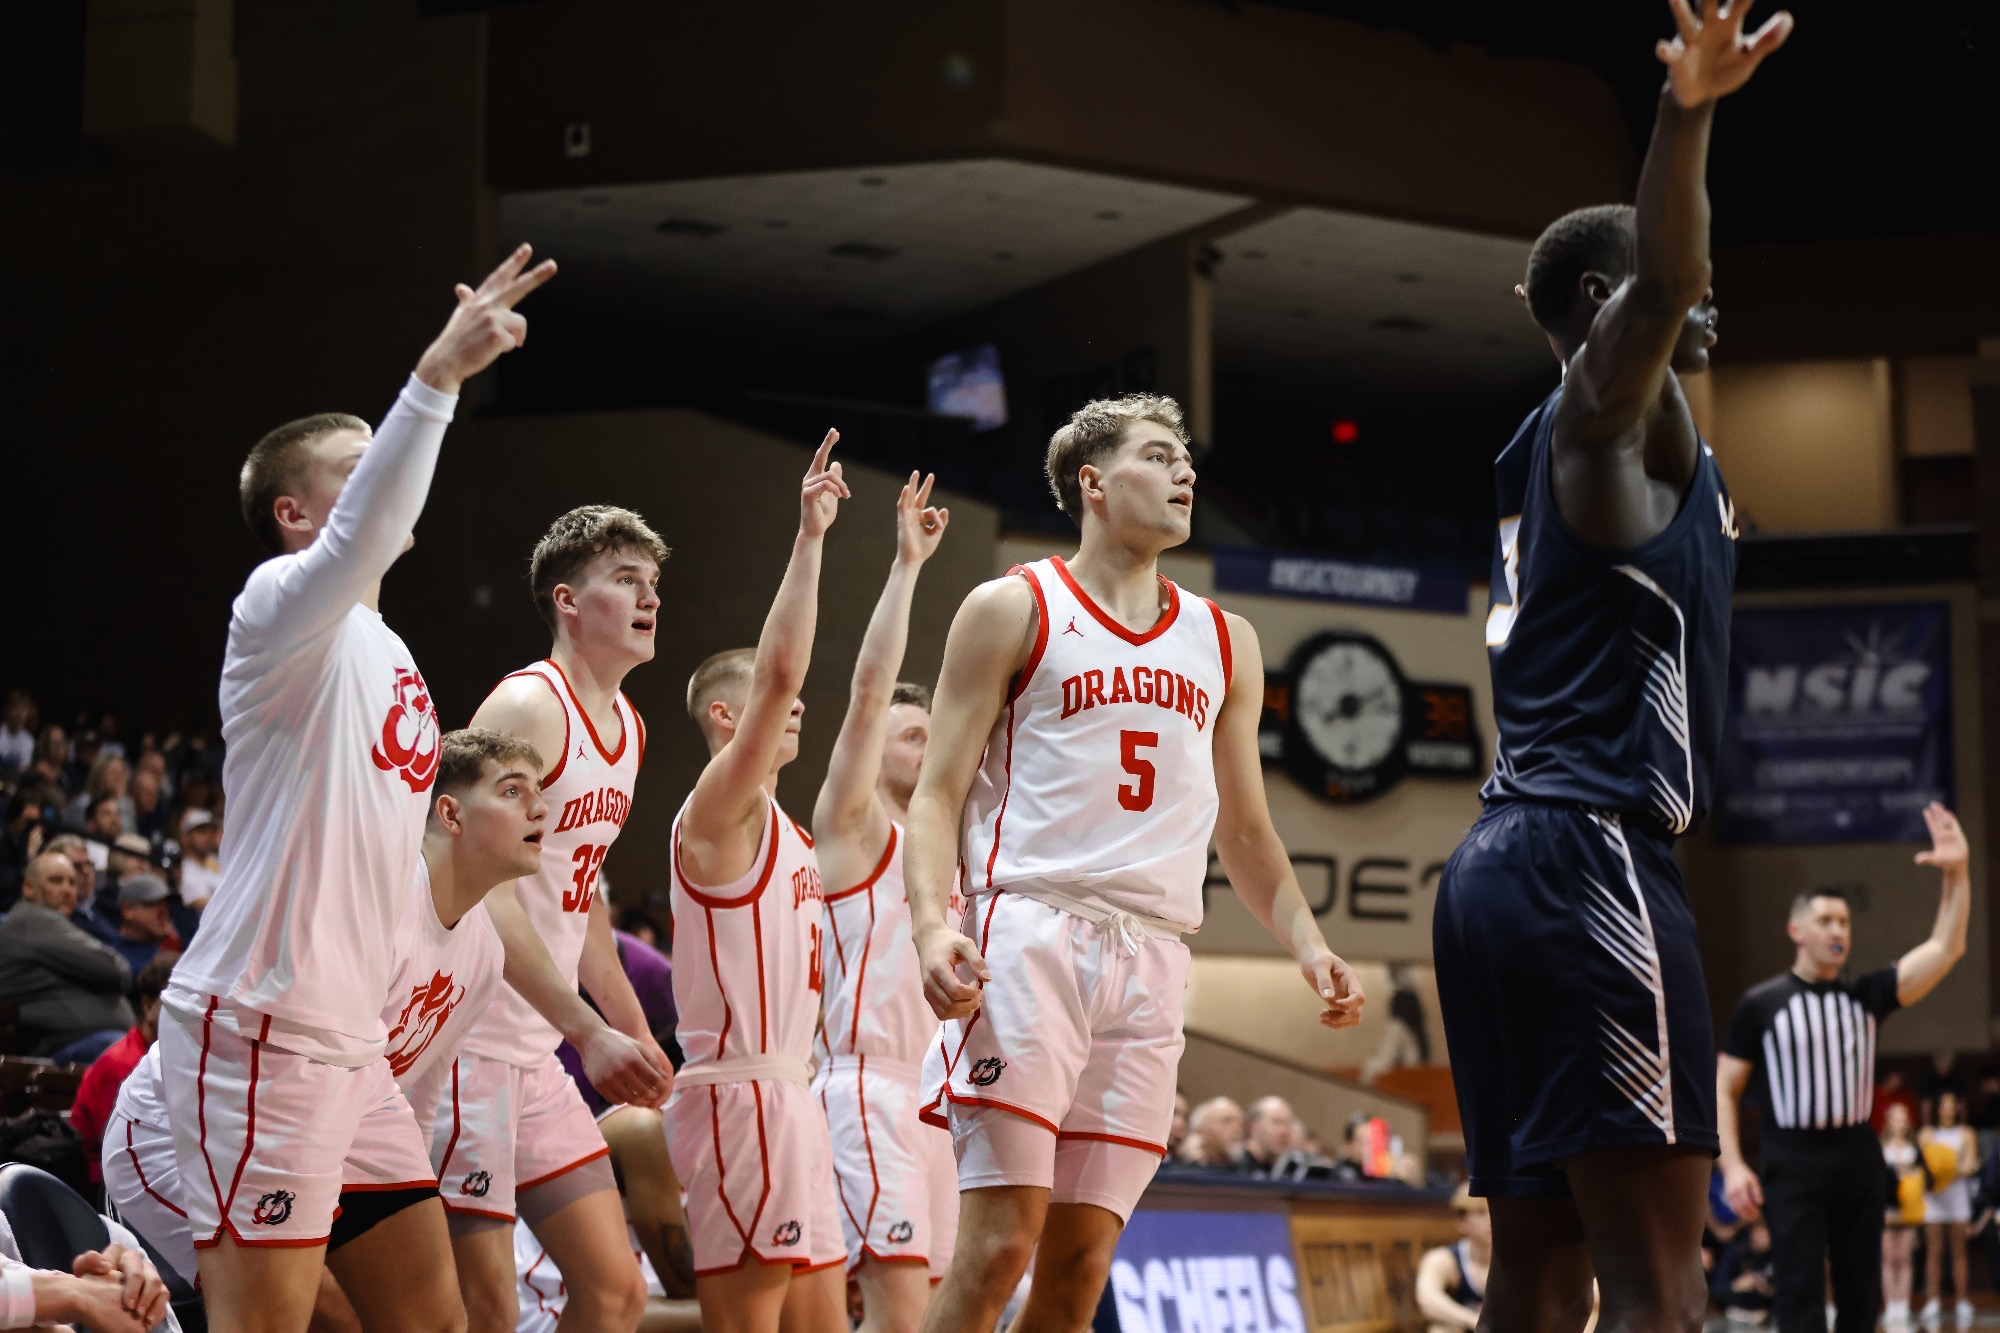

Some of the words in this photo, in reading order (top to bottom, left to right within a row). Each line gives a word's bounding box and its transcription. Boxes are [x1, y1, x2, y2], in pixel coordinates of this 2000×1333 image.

[1061, 666, 1210, 732] DRAGONS
[1118, 730, 1159, 812] 5
[562, 844, 608, 913] 32
[1110, 1254, 1308, 1333] SCHEELS
